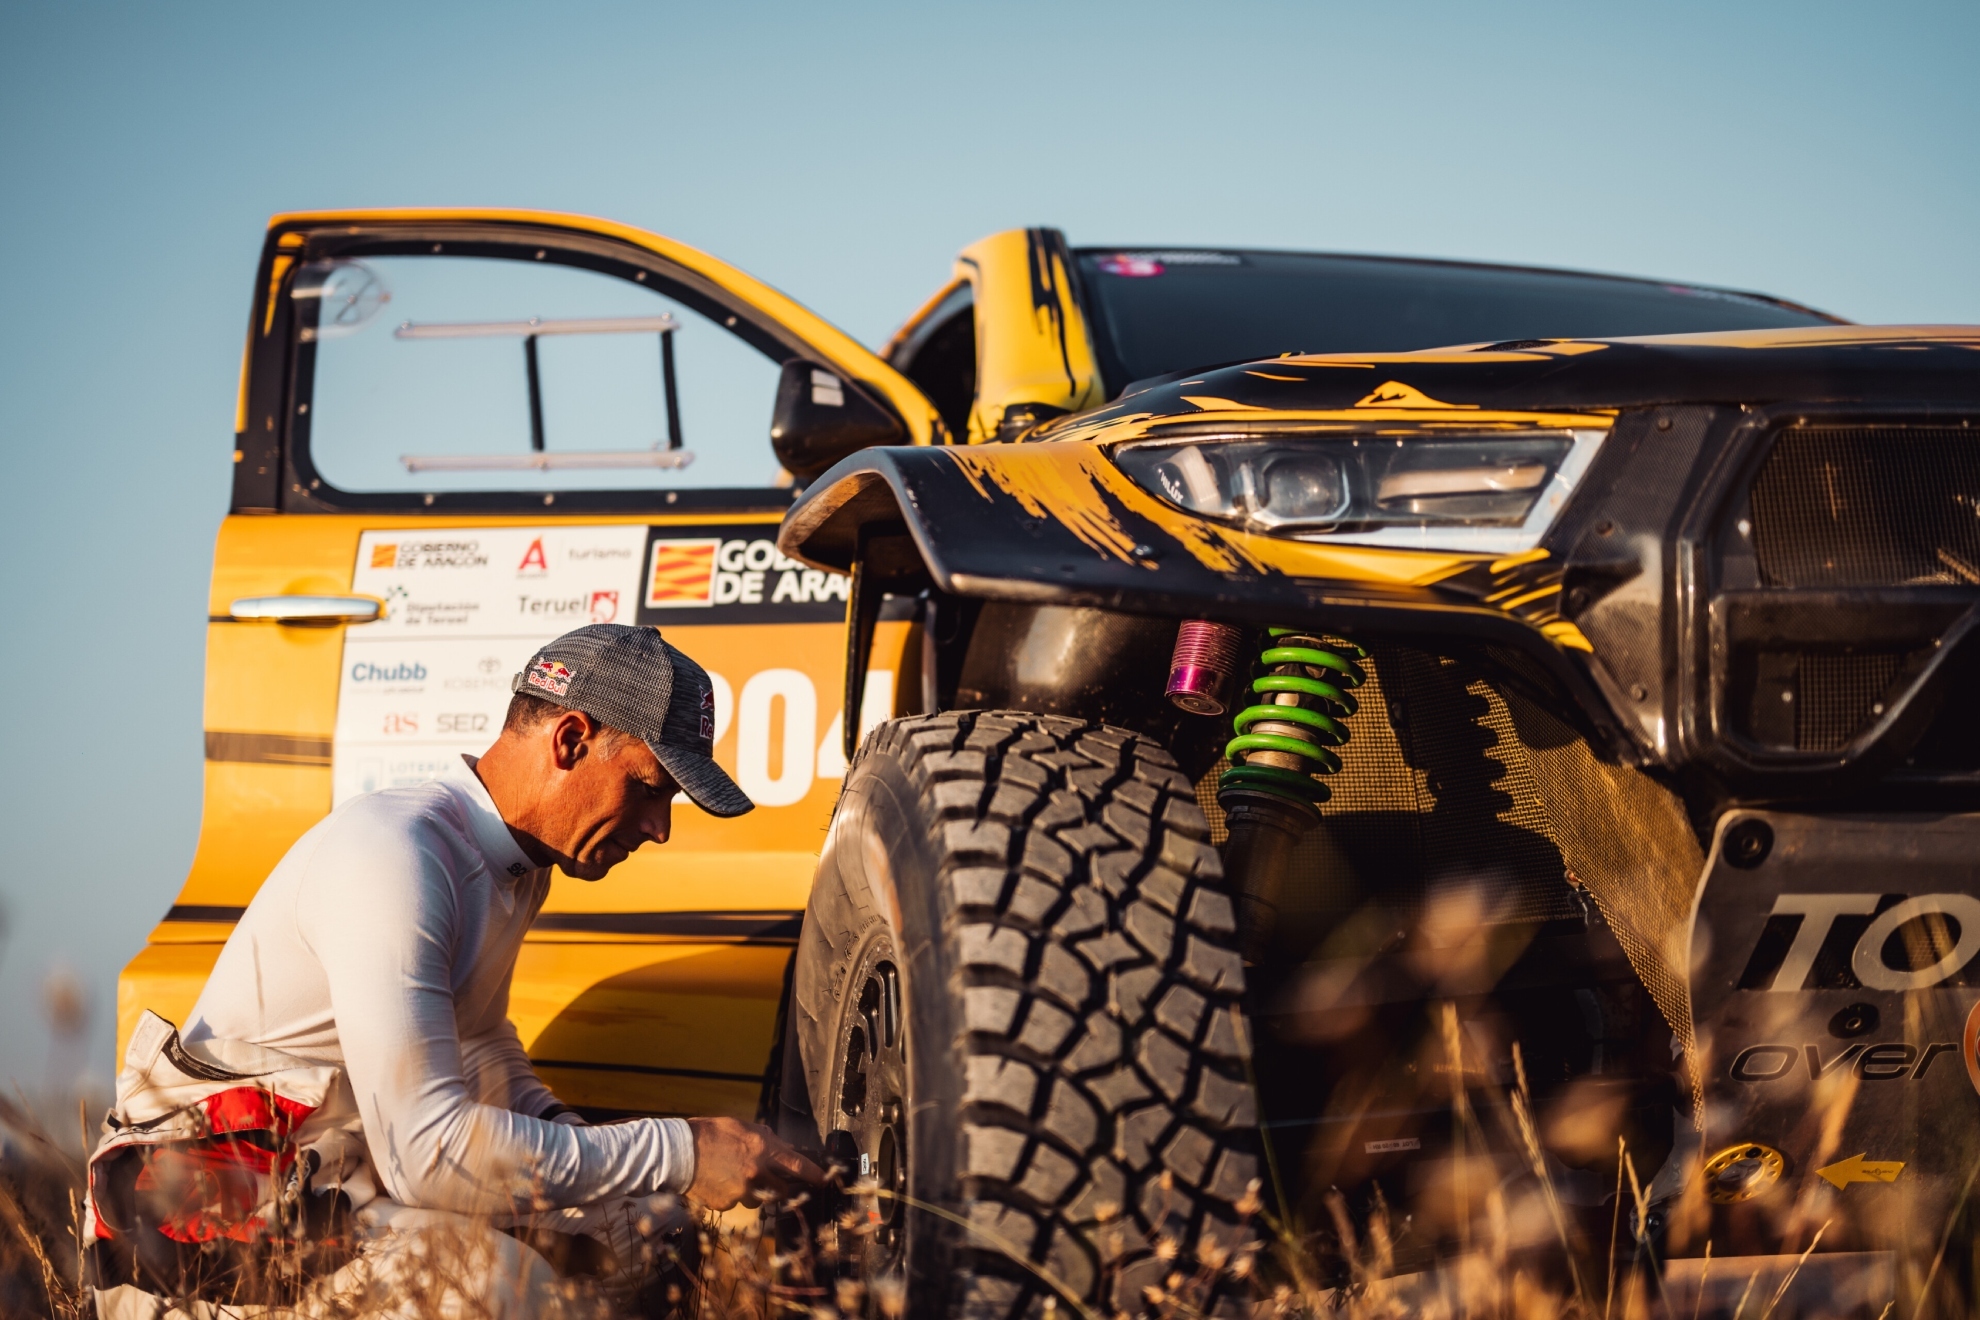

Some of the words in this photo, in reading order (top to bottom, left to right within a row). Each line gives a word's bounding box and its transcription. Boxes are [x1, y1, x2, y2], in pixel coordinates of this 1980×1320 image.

[400, 541, 479, 553] GOBIERNO
[568, 546, 632, 560] turismo
[397, 557, 416, 569] DE
[715, 570, 766, 604] DE
[519, 594, 588, 614] Teruel
[351, 662, 428, 682] Chubb
[528, 671, 549, 689] Red
[546, 679, 568, 696] Bull
[382, 711, 420, 735] as
[436, 712, 490, 733] SER
[1729, 1042, 1959, 1082] over
